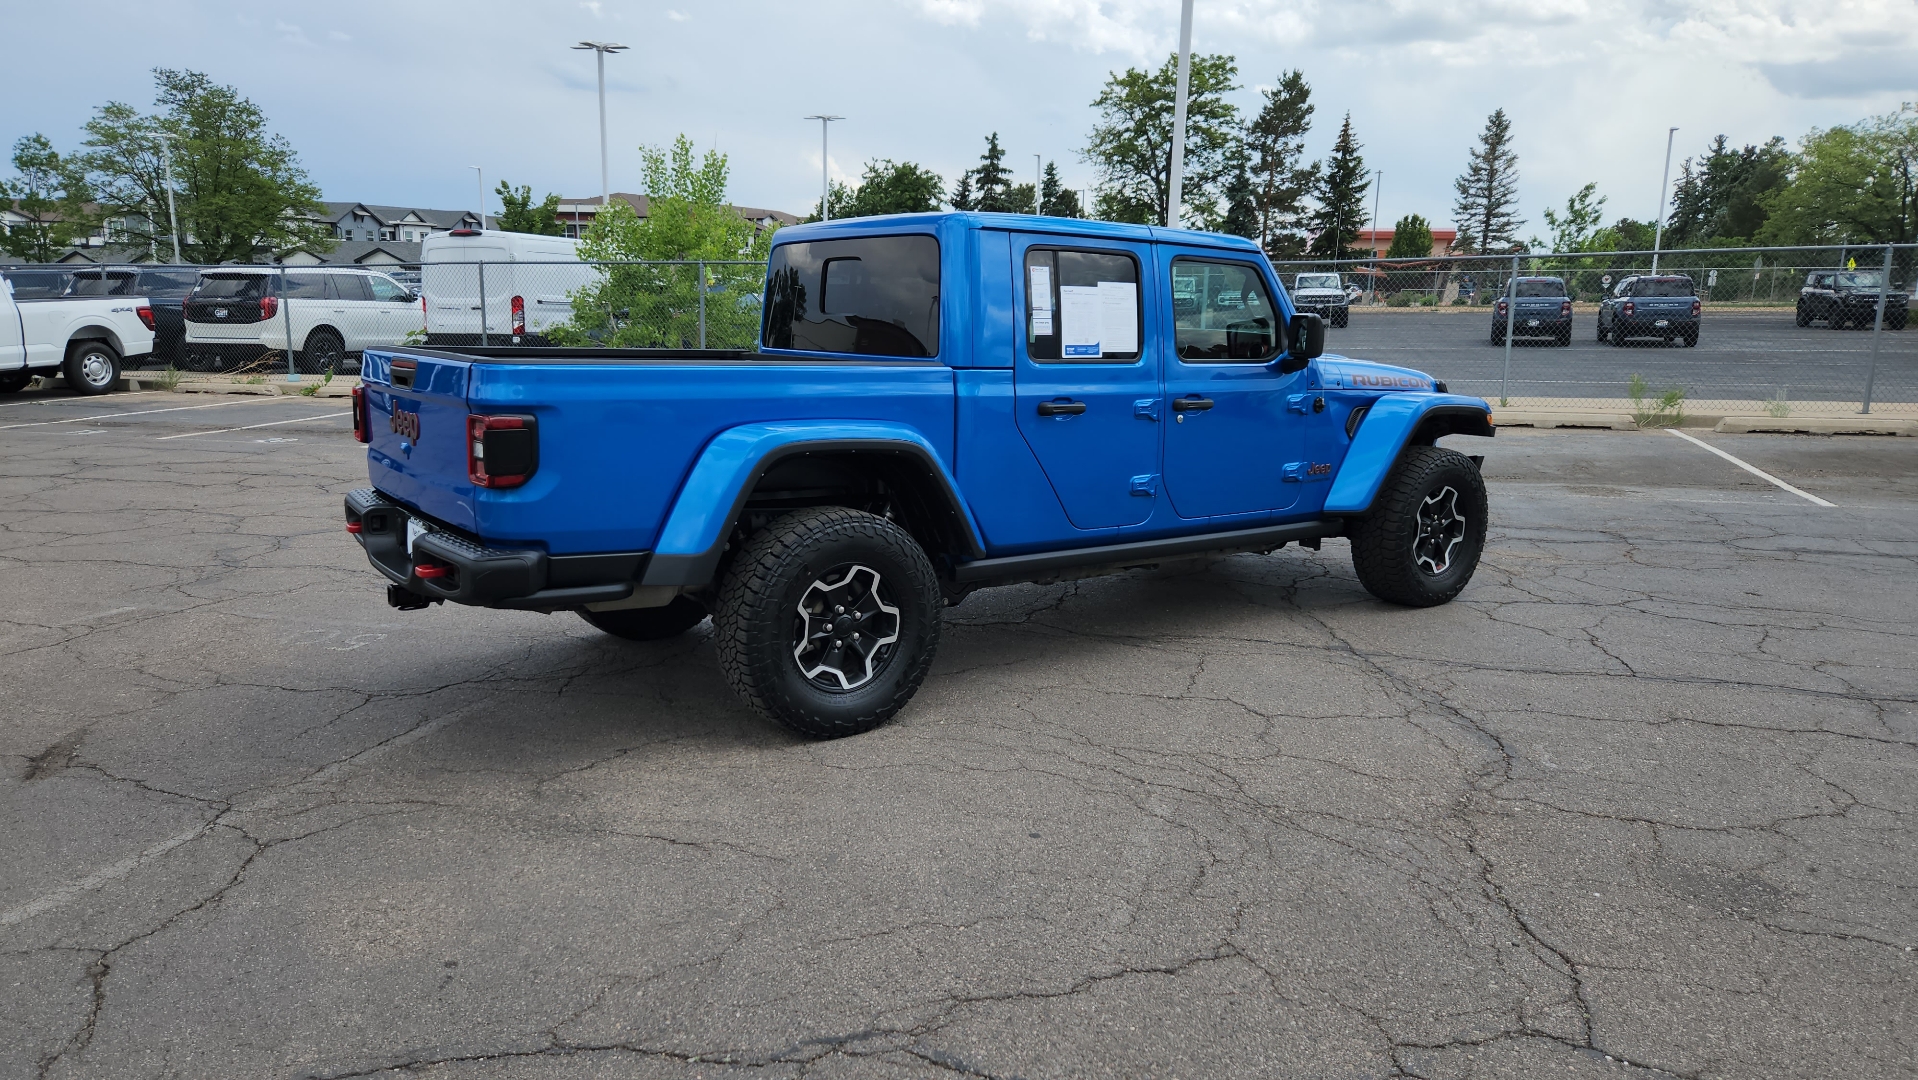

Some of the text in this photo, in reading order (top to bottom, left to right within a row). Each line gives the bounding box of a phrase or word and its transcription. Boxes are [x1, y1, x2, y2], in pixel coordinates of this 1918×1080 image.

[1352, 374, 1432, 389] RUBICON
[389, 399, 421, 447] Jeep
[1307, 461, 1331, 476] Jeep
